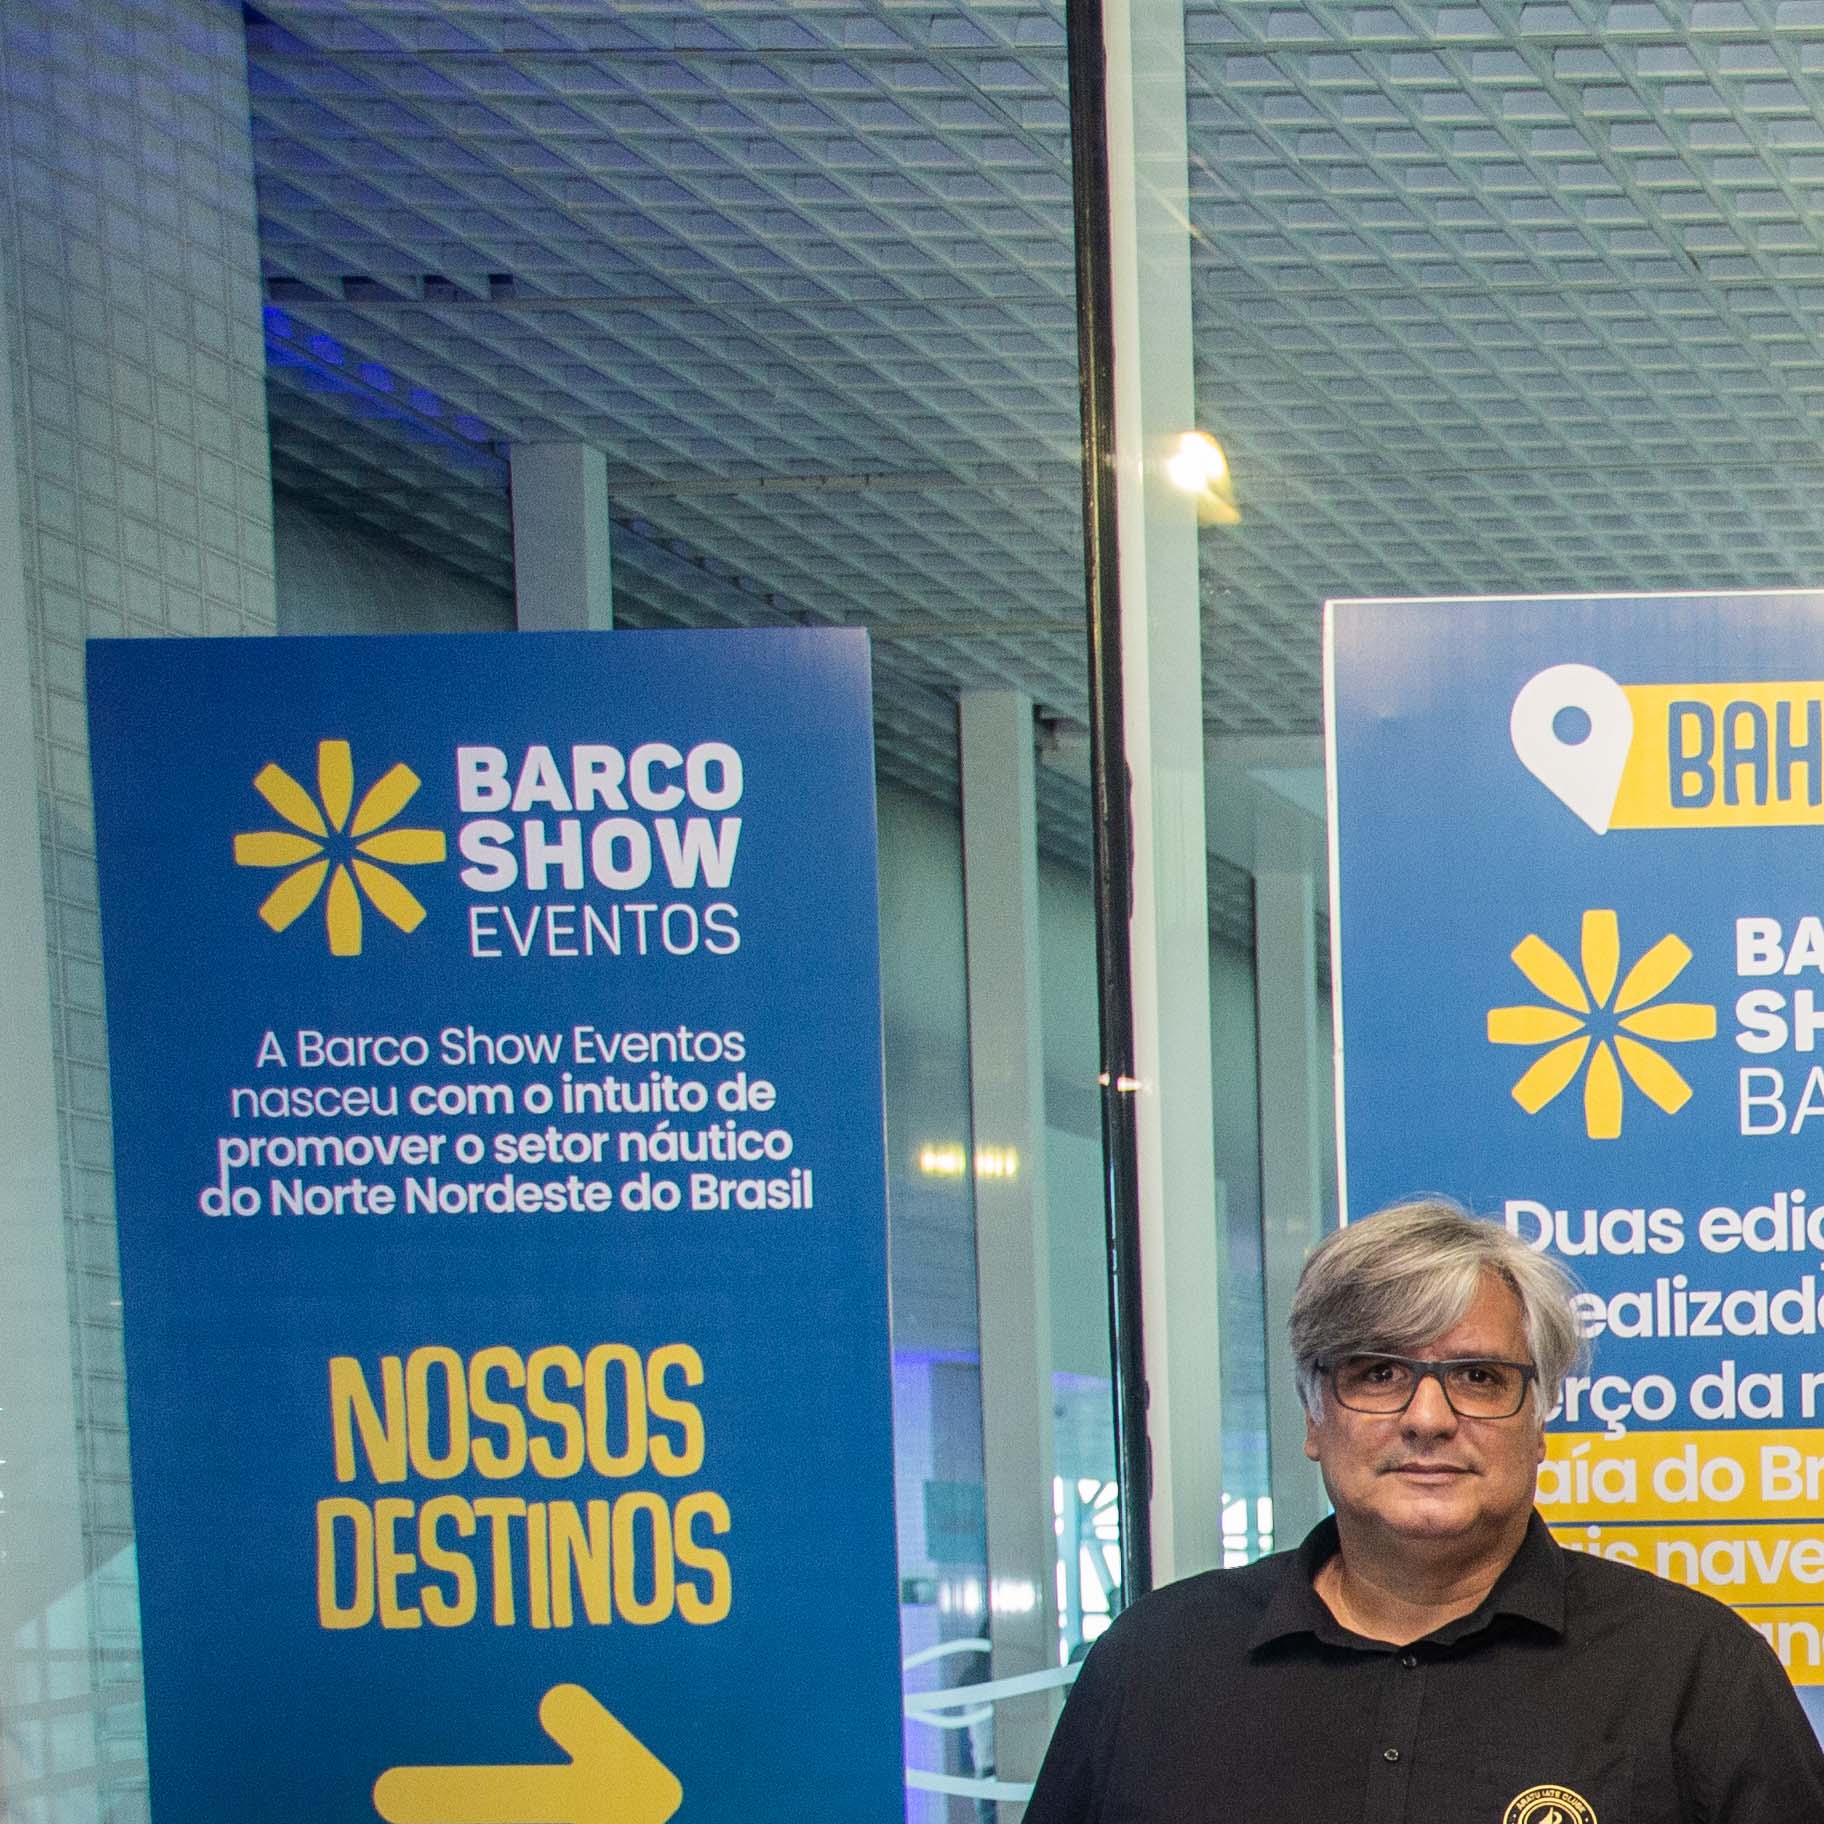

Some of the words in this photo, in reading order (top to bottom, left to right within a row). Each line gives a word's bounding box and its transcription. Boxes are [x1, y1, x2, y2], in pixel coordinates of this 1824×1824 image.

[456, 740, 745, 814] BARCO
[457, 816, 744, 893] SHOW
[468, 902, 742, 959] EVENTOS
[255, 1030, 287, 1069] A
[297, 1029, 429, 1068] Barco
[439, 1025, 563, 1066] Show
[573, 1024, 747, 1065] Eventos
[230, 1084, 399, 1120] nasceu
[408, 1082, 516, 1117] com
[522, 1082, 555, 1115] o
[561, 1072, 708, 1115] intuito
[715, 1071, 777, 1113] de
[217, 1130, 448, 1184] promover
[454, 1132, 486, 1166] o
[493, 1125, 610, 1165] setor
[617, 1117, 795, 1164] náutico
[199, 1174, 262, 1218] do
[270, 1175, 397, 1217] Norte
[404, 1172, 613, 1215] Nordeste
[619, 1170, 682, 1213] do
[689, 1168, 814, 1212] Brasil
[1504, 1199, 1686, 1257] Duas
[328, 1343, 706, 1484] NOSSOS
[1543, 1372, 1677, 1441] rço
[1689, 1359, 1785, 1421] da
[1534, 1441, 1638, 1505] aía
[1651, 1443, 1746, 1503] do
[315, 1490, 733, 1630] DESTINOS
